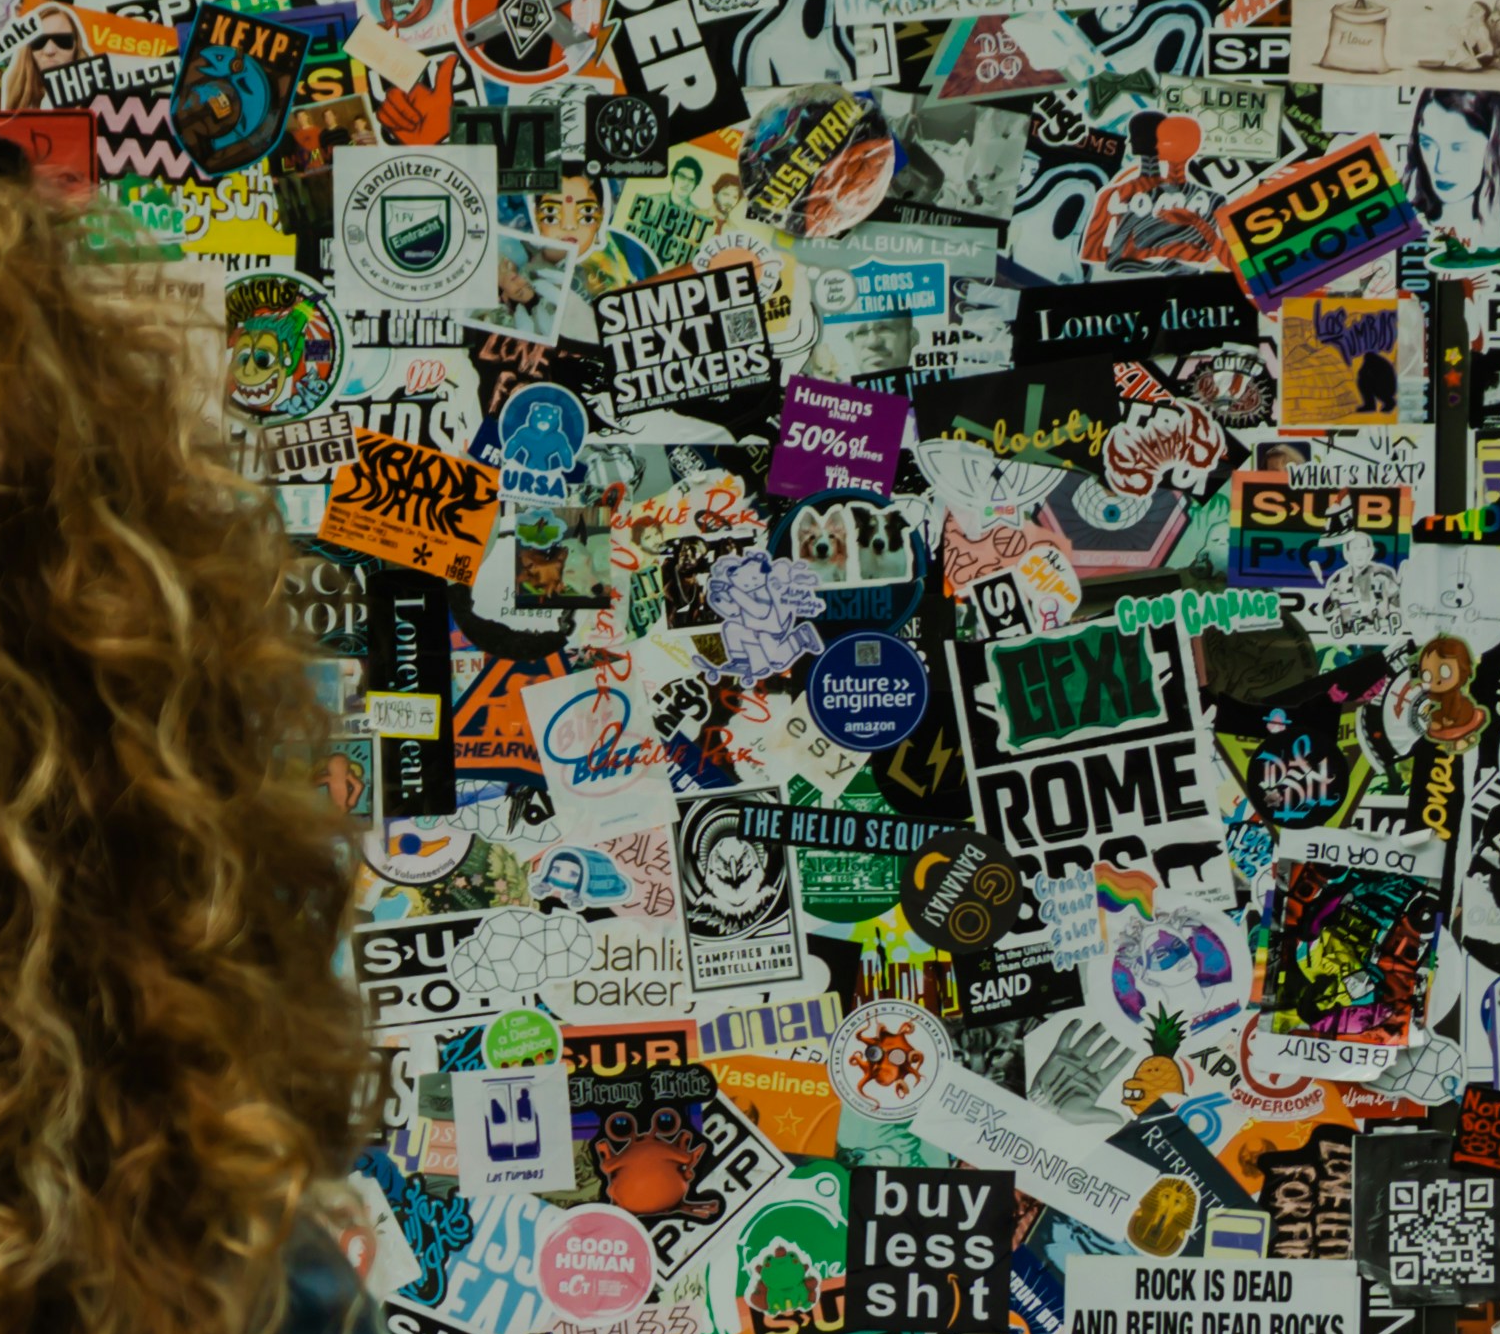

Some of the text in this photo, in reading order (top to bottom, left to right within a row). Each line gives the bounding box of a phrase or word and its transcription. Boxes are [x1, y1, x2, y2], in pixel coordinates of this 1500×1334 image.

[599, 267, 754, 335] SIMPLE
[1039, 305, 1241, 343] Loney, dear.
[604, 315, 712, 371] TEXT
[614, 343, 770, 403] STICKERS
[794, 387, 872, 416] Humans
[829, 409, 857, 423] share
[784, 422, 867, 457] 50% of
[850, 450, 883, 462] genes
[503, 470, 566, 499] URSA
[821, 673, 888, 695] future
[821, 689, 916, 710] engineer
[845, 719, 894, 732] amazon
[697, 943, 792, 965] CAMPFIRES AND
[699, 957, 793, 978] CONSTELLATIONS
[874, 1175, 989, 1228] buy
[567, 1238, 627, 1255] GOOD
[863, 1225, 994, 1268] less
[556, 1256, 634, 1273] HUMAN
[1135, 1270, 1293, 1302] ROCK IS DEAD
